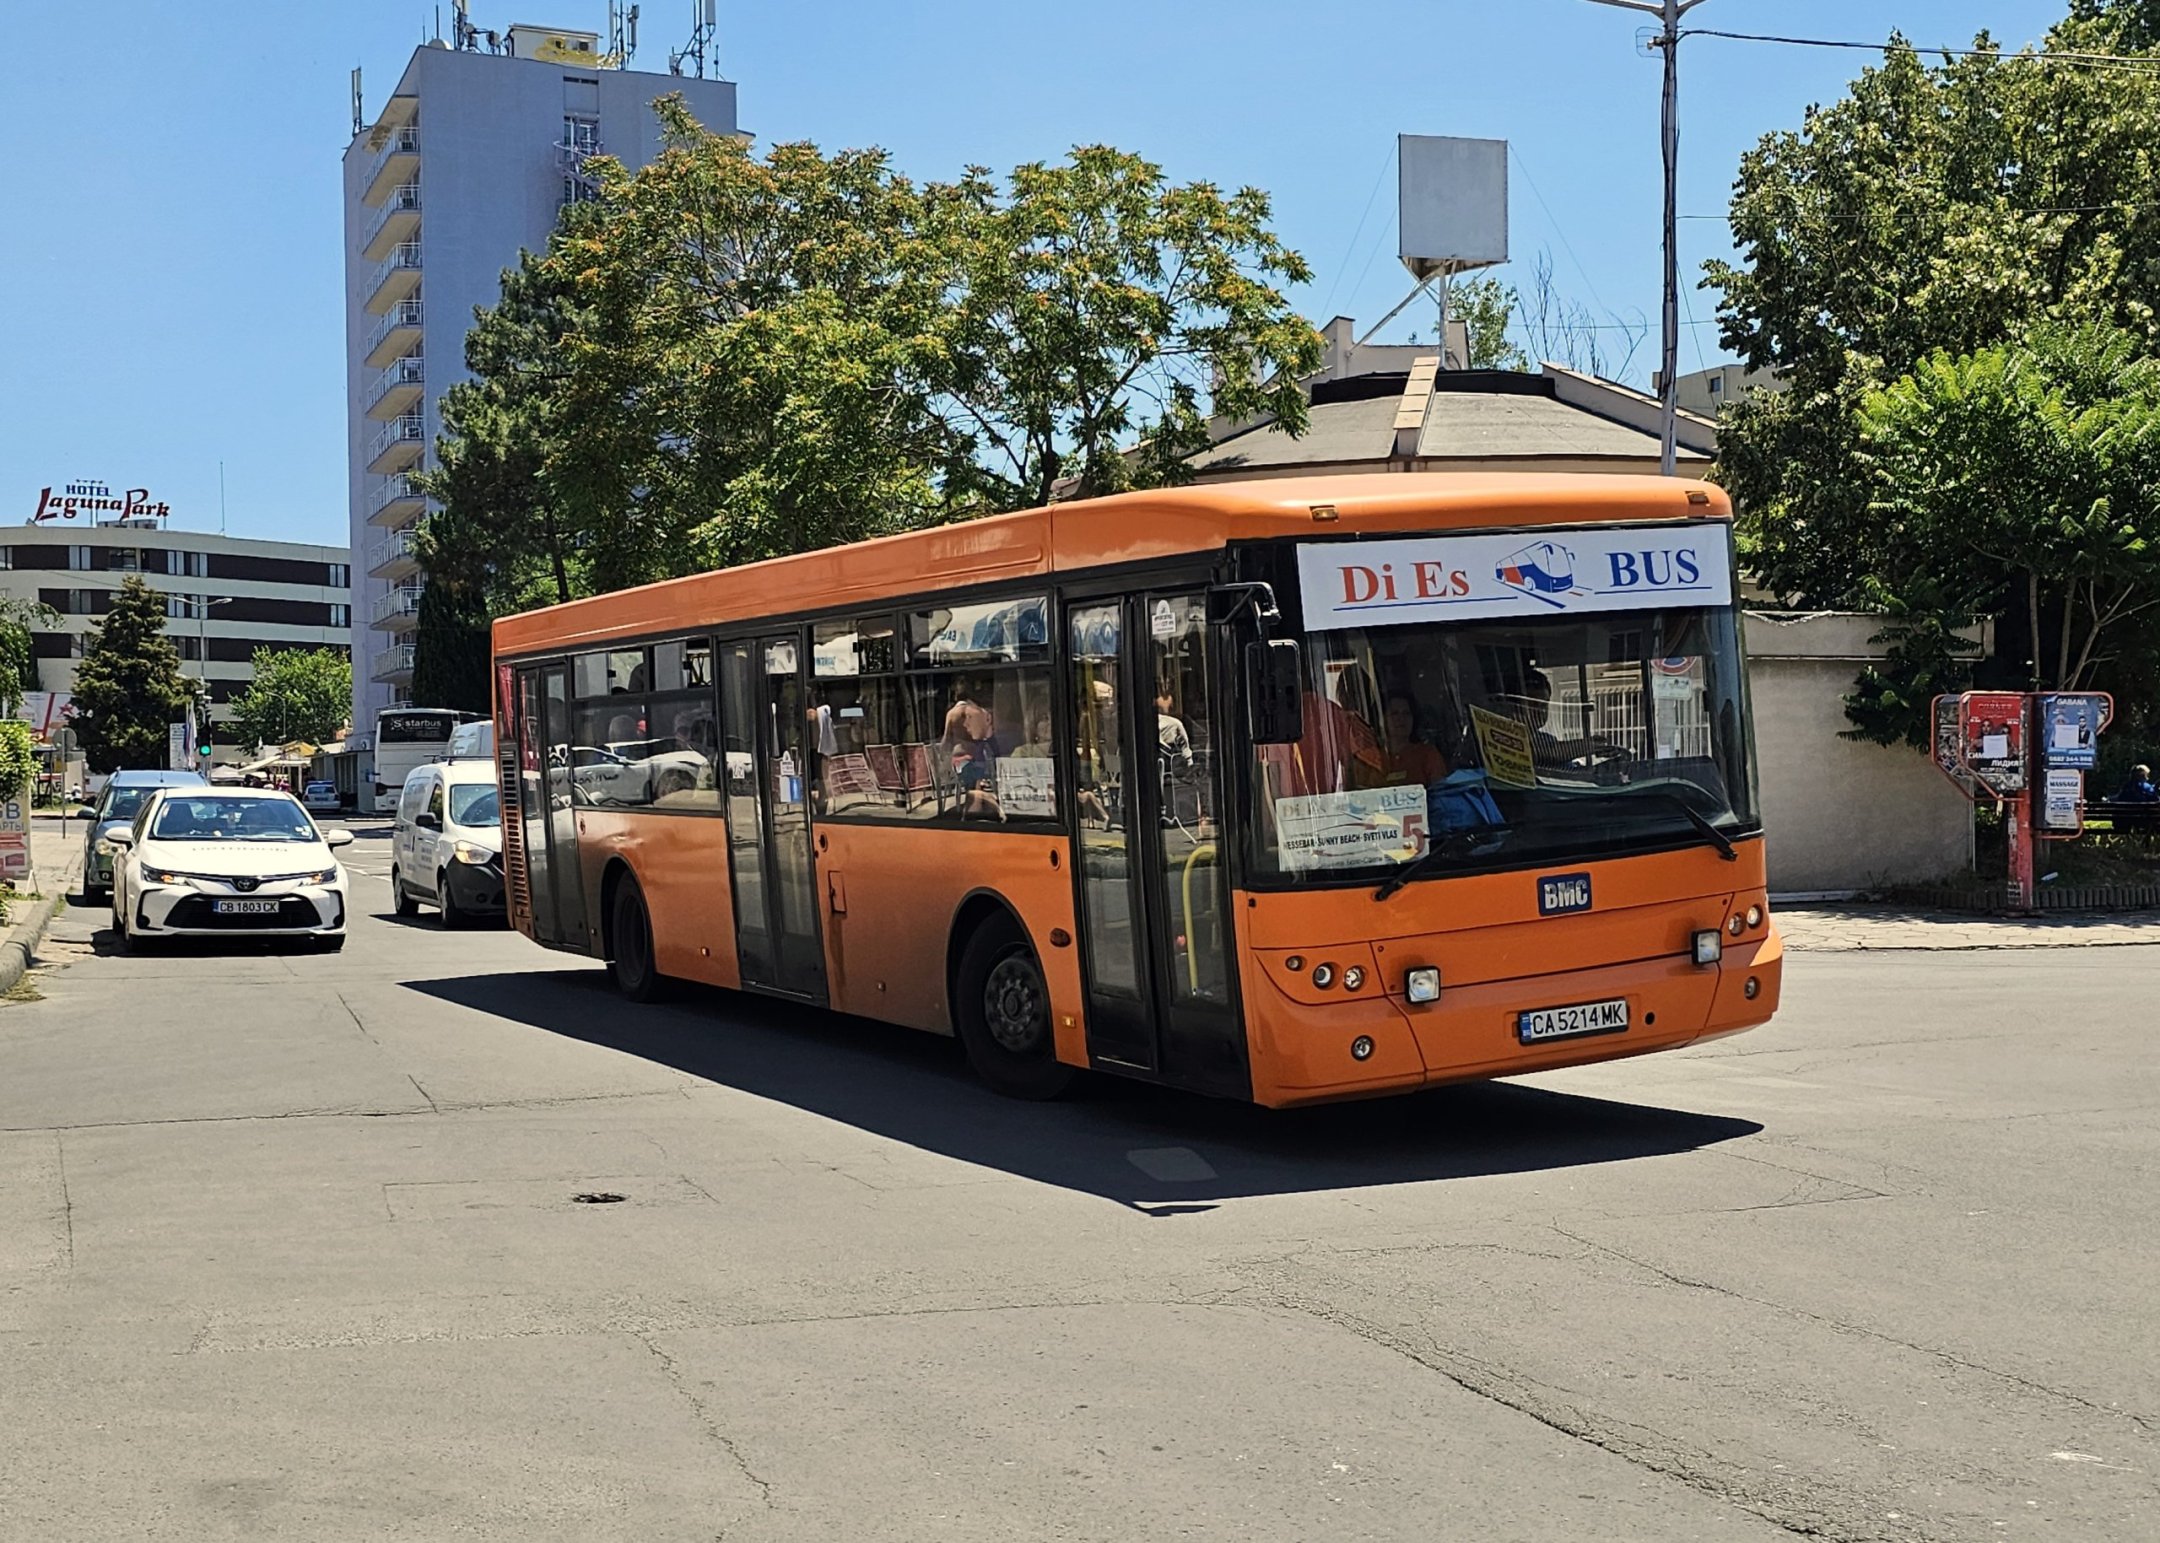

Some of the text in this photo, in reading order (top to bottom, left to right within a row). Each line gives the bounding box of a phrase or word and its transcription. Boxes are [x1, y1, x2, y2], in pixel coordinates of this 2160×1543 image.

[66, 485, 112, 496] HOTEL
[34, 487, 170, 522] Laguna Park
[1411, 561, 1470, 598] Es
[1605, 548, 1700, 587] BUS
[1380, 790, 1419, 807] BUS
[1382, 829, 1398, 840] VLAS
[1402, 814, 1426, 855] 5
[1544, 879, 1588, 909] BMC
[238, 902, 261, 912] 1803
